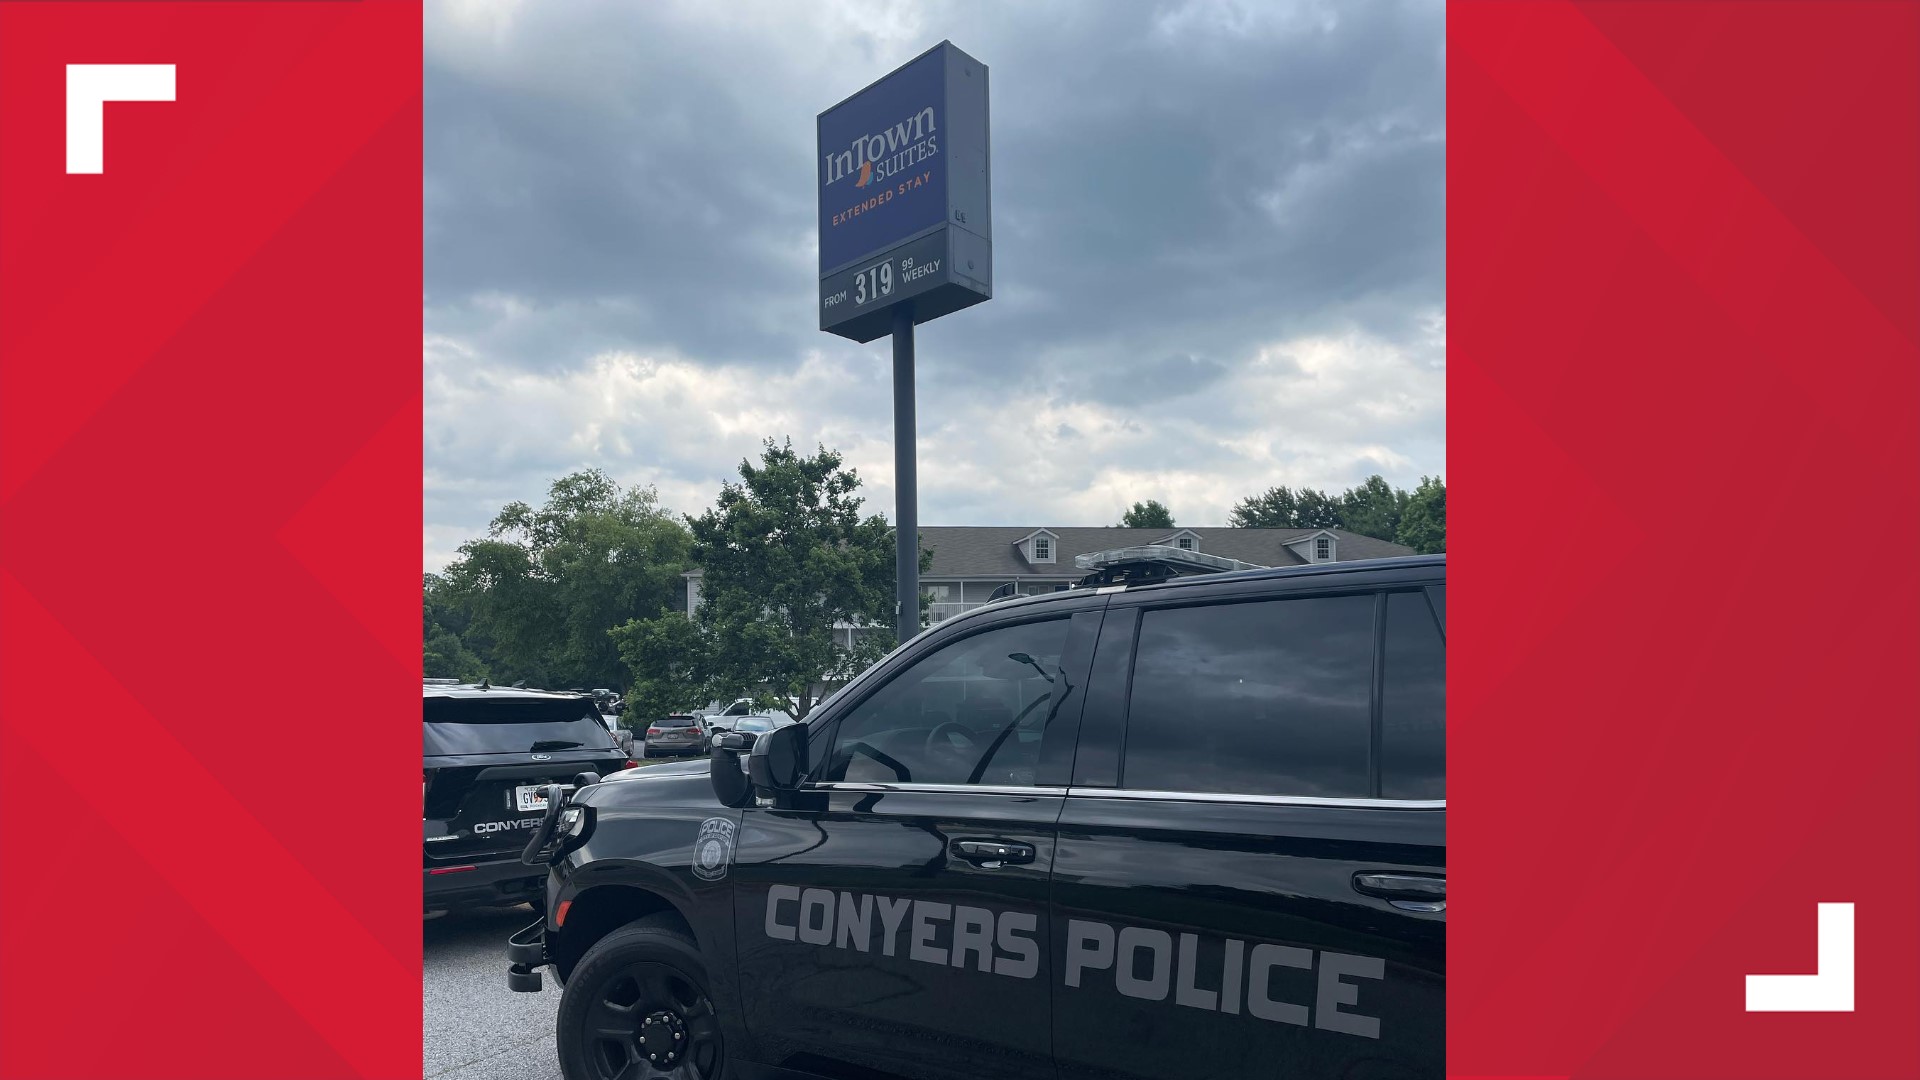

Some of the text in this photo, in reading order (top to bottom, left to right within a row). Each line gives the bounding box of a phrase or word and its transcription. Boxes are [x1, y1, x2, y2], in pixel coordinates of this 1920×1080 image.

[825, 106, 936, 186] InTown
[876, 135, 938, 183] SUITES
[832, 171, 932, 227] EXTENDED STAY
[824, 262, 893, 309] FROM 319
[902, 257, 914, 270] 99
[902, 259, 941, 284] WEEKLY
[700, 820, 733, 838] POLICE
[765, 884, 1386, 1039] CONYERS POLICE
